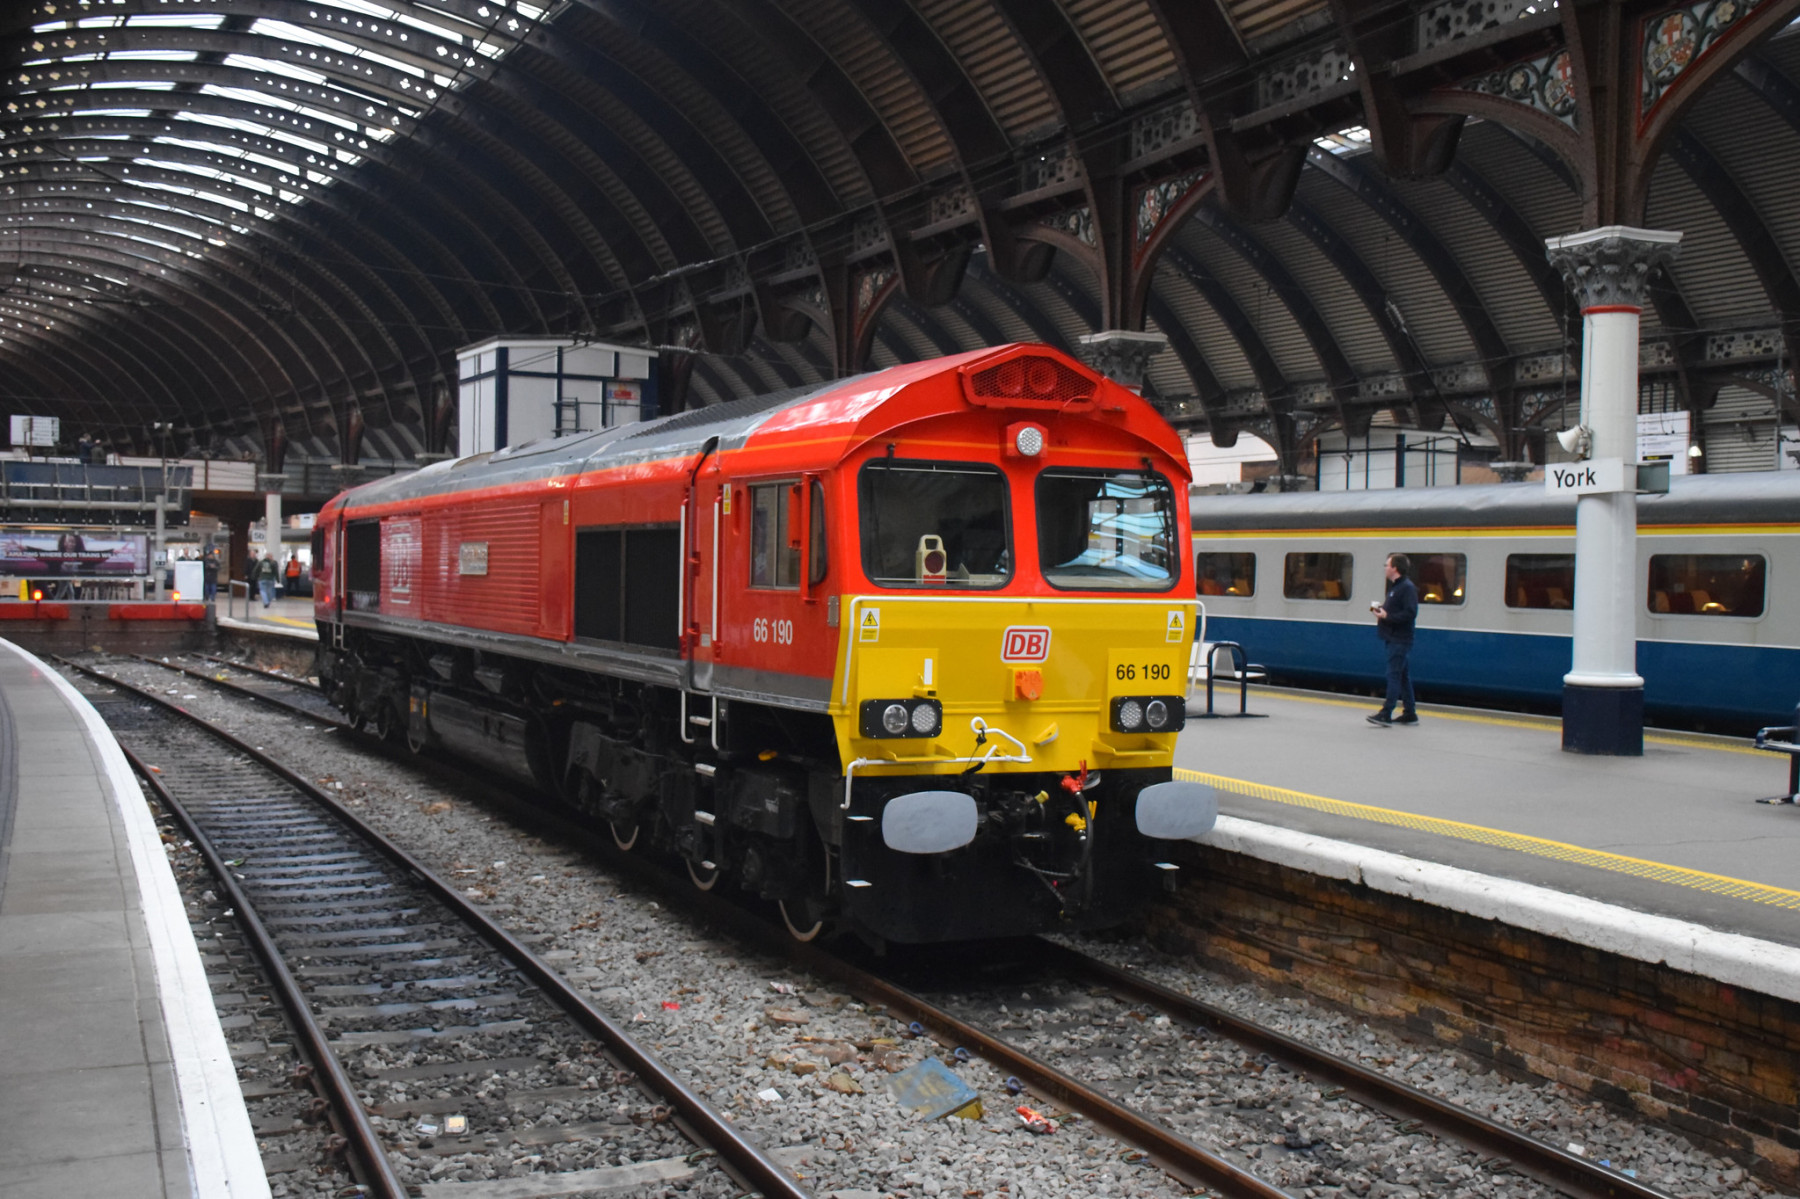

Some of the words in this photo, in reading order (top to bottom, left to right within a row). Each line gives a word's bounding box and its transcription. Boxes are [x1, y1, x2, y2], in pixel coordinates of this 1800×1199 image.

[1553, 467, 1597, 488] York
[753, 617, 768, 643] 66
[771, 619, 793, 645] 190
[1009, 633, 1043, 655] DB
[1116, 664, 1136, 680] 66
[1142, 664, 1171, 680] 190
